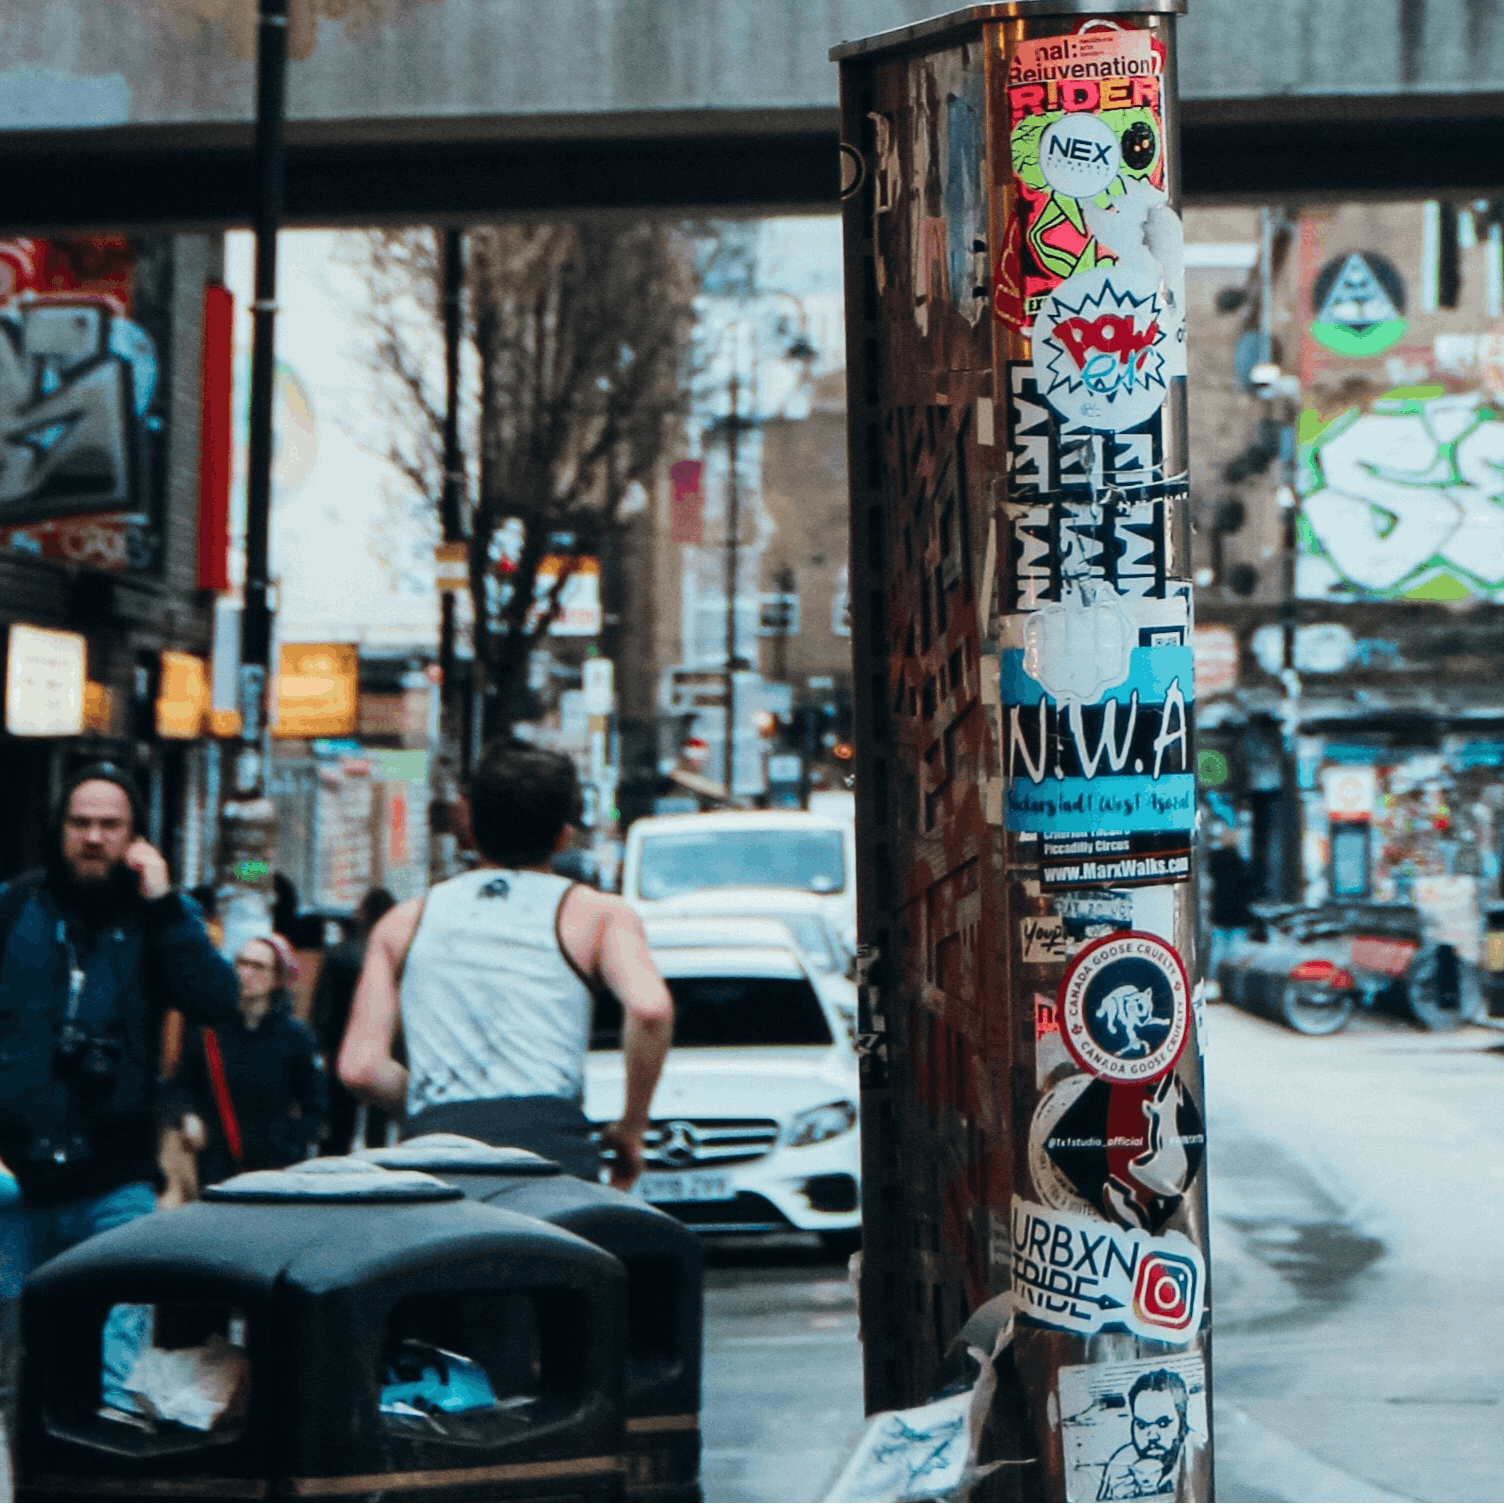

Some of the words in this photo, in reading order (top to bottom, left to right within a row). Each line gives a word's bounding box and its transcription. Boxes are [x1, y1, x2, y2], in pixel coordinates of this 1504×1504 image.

[1009, 56, 1150, 82] Rejuvenation
[1049, 134, 1112, 165] NEX
[1009, 675, 1188, 789] N.W.A
[1043, 841, 1094, 855] Piccadilly
[1095, 840, 1130, 852] Circus
[1069, 966, 1093, 1016] CANADA
[1092, 943, 1133, 965] GOOSE
[1137, 943, 1176, 976] CRUELTY
[1081, 1041, 1126, 1073] CANADA
[1130, 1054, 1166, 1074] GOOSE
[1166, 1001, 1183, 1052] CRUELTY
[1013, 1207, 1140, 1283] URBXN
